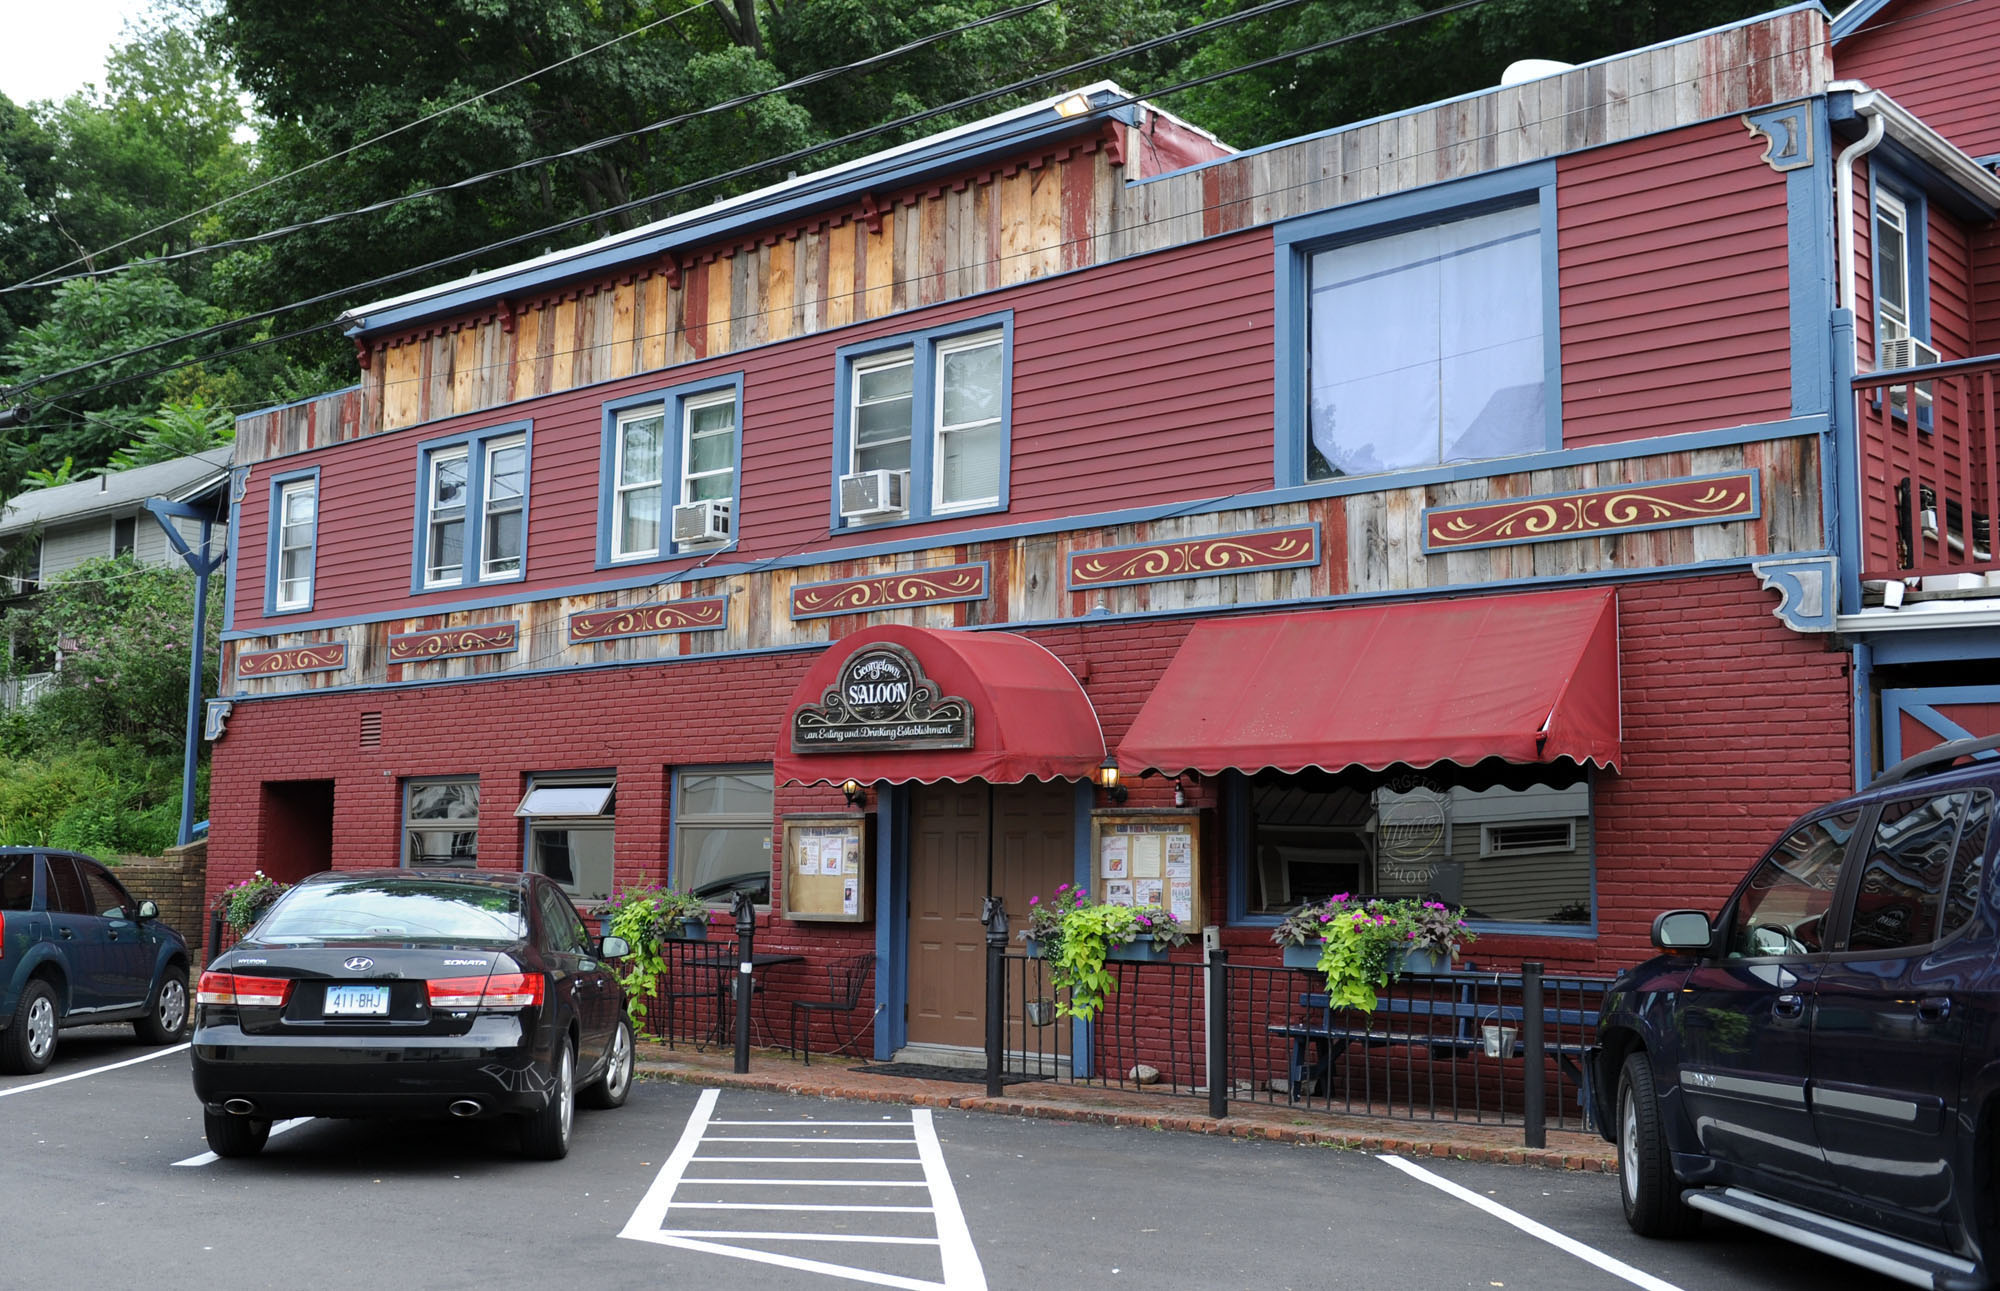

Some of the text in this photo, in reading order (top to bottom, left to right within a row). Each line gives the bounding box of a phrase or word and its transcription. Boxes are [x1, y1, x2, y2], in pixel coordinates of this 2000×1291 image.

[853, 659, 900, 680] Georgetown
[849, 682, 908, 705] SALOON
[819, 728, 843, 741] Eating
[845, 730, 859, 738] and
[861, 727, 896, 741] Drinking
[897, 724, 953, 737] Establishment
[1384, 861, 1440, 884] SALOON
